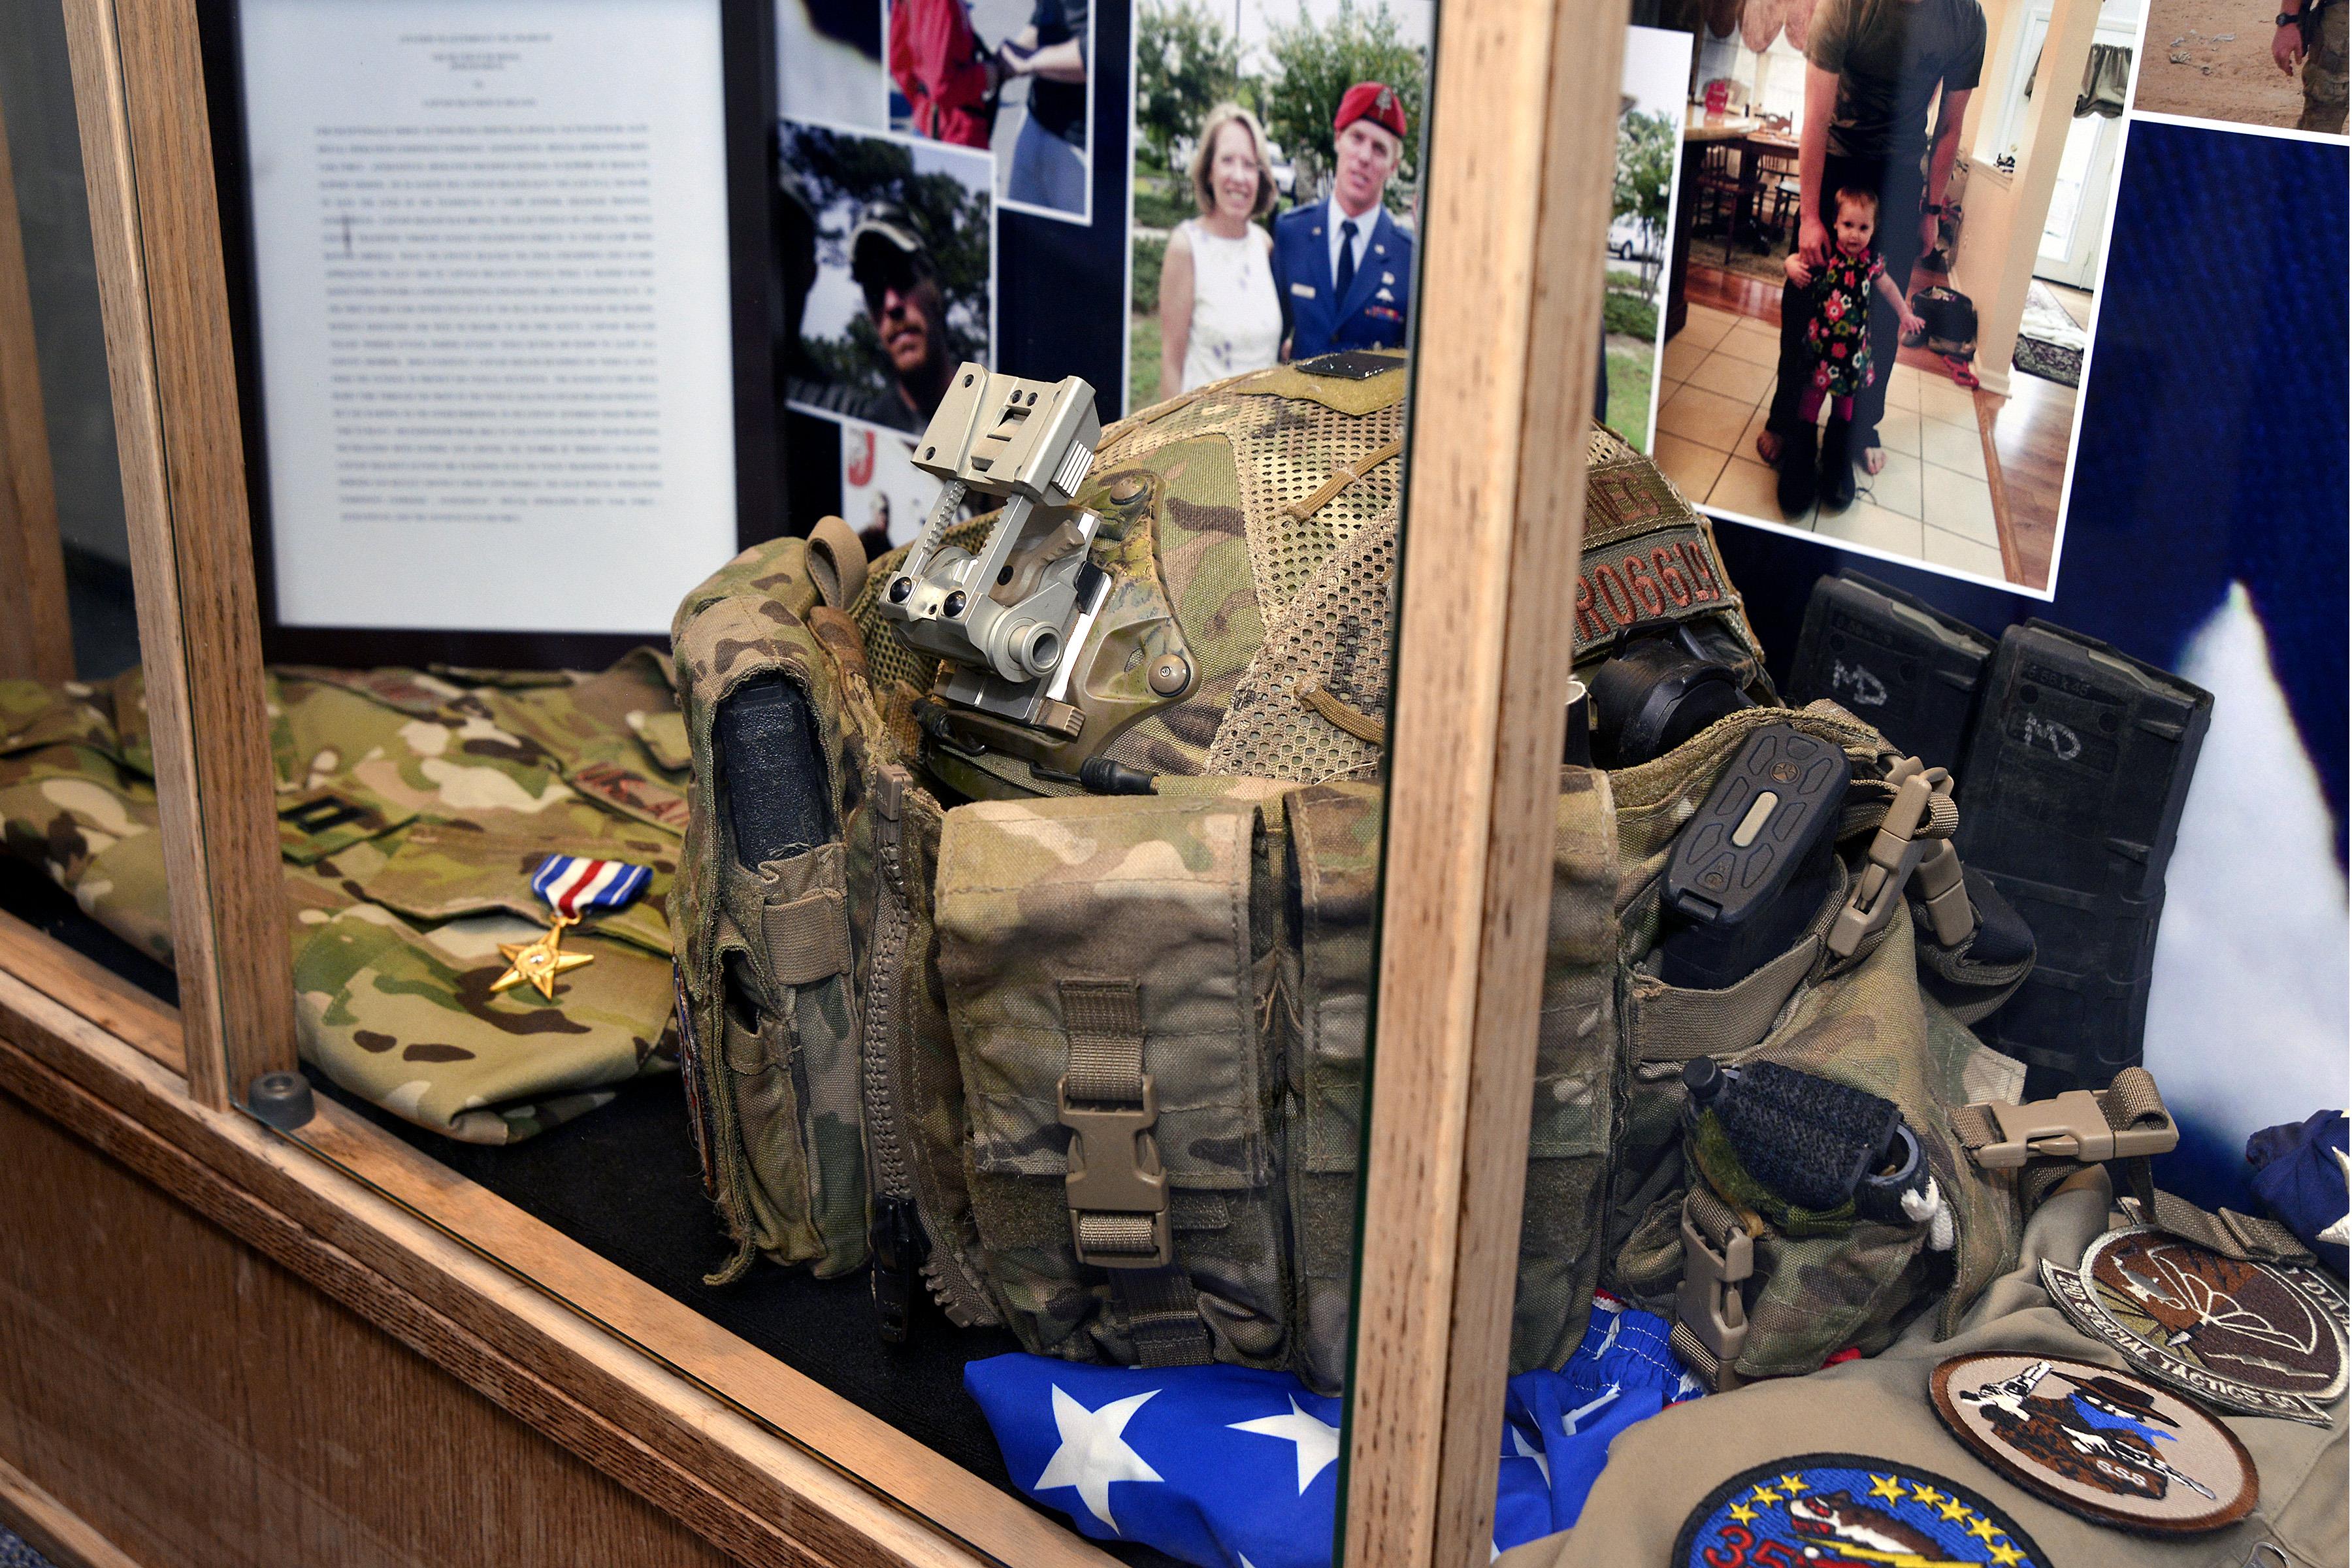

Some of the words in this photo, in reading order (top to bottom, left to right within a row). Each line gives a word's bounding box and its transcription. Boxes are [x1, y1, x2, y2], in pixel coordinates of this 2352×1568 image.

[1832, 659, 1887, 706] MD
[2023, 712, 2081, 760] MD
[2075, 1302, 2152, 1360] SPECIAL
[2159, 1354, 2262, 1403] TACTICS
